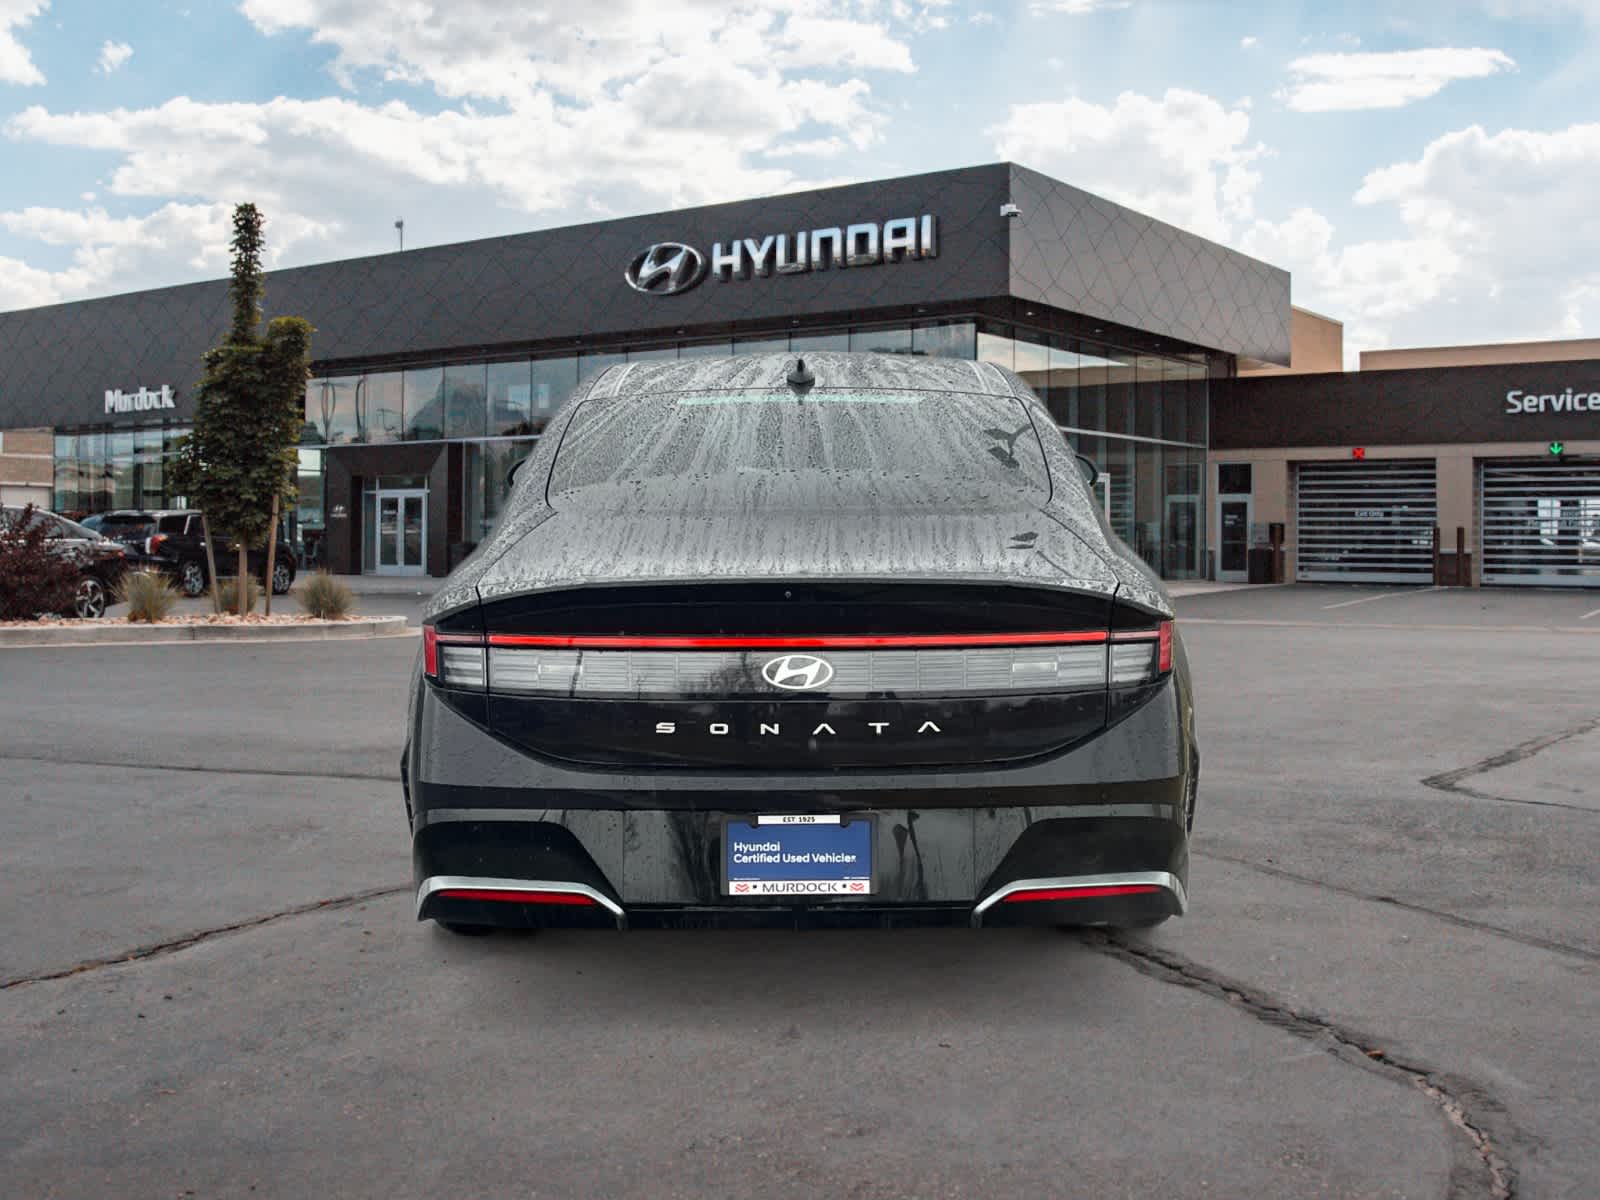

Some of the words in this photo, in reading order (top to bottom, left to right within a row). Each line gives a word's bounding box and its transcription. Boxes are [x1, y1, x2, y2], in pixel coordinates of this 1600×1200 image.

[712, 214, 936, 282] HYUNDAI
[105, 384, 176, 414] Murdock
[1505, 387, 1600, 413] Service
[655, 720, 941, 736] SONATA
[733, 841, 781, 854] Hyundai
[733, 853, 780, 864] Certified
[782, 853, 810, 863] Used
[762, 882, 838, 893] MURDOCK
